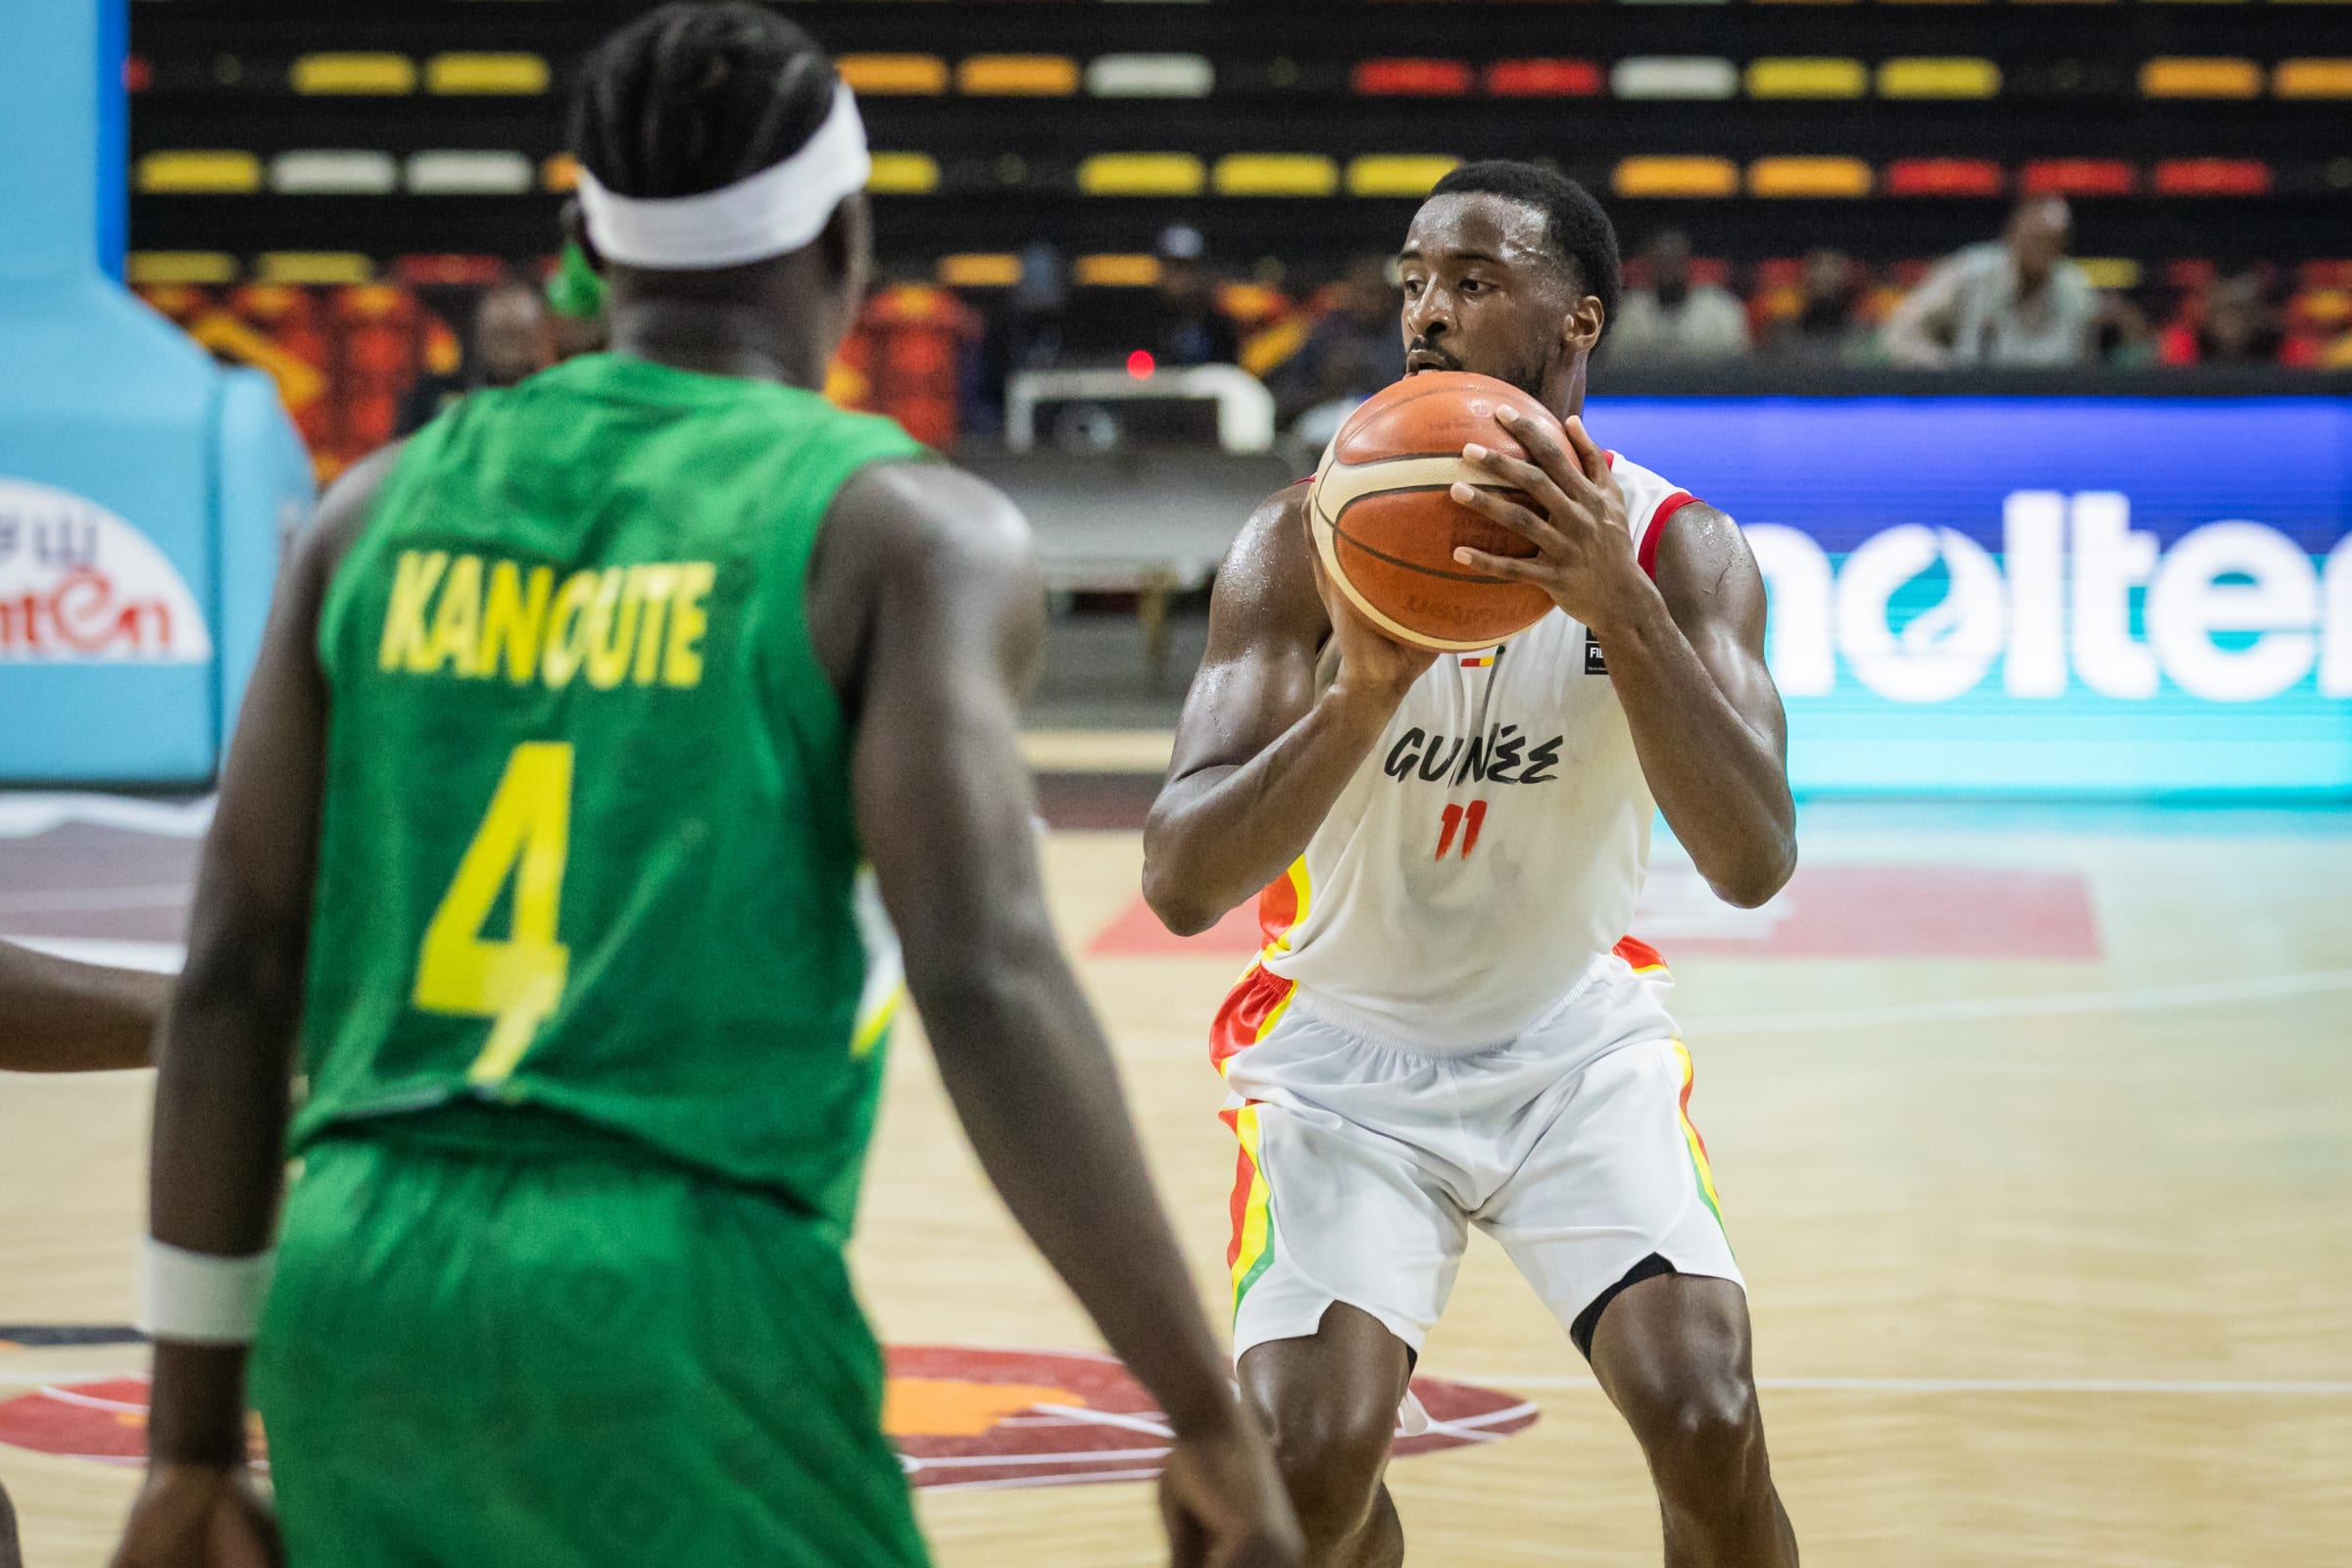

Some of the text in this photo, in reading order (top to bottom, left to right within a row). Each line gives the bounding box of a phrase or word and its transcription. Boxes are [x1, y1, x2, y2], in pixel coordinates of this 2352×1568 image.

[378, 550, 716, 690] KANOUTE
[1744, 491, 2352, 703] olte
[412, 740, 575, 1086] 4
[1435, 800, 1488, 862] 11
